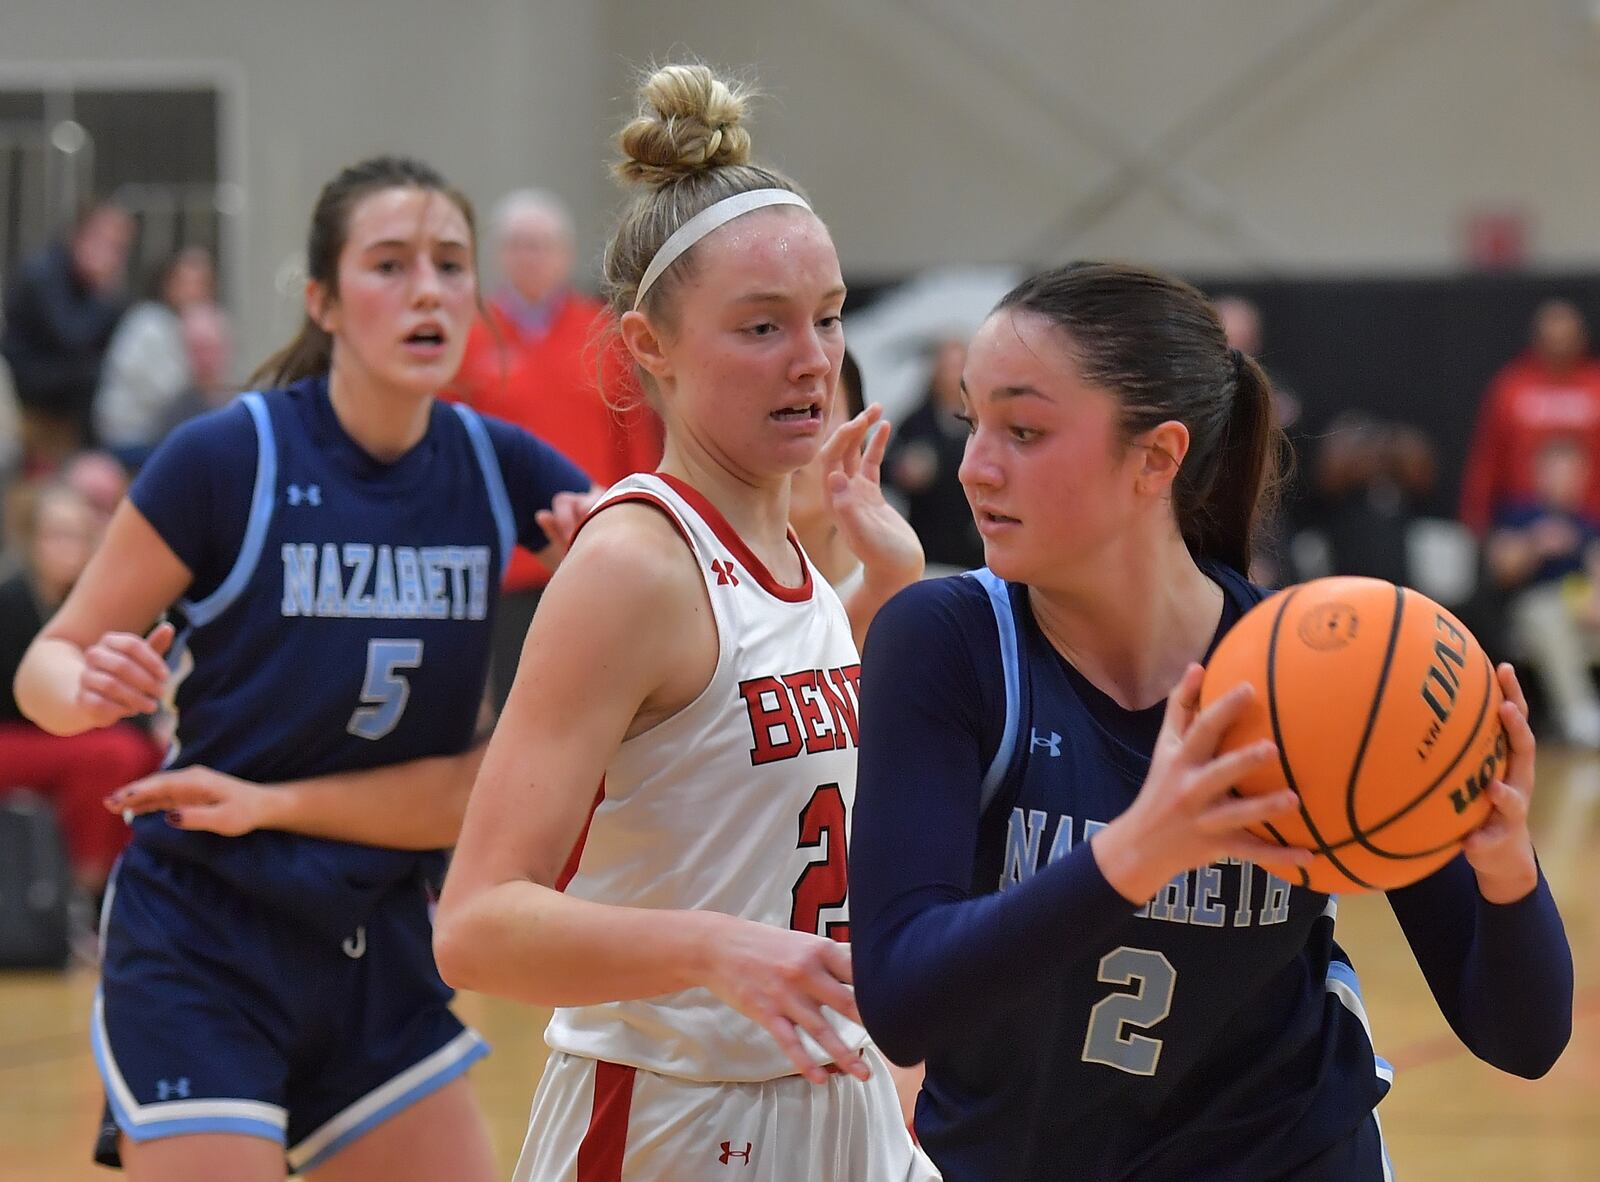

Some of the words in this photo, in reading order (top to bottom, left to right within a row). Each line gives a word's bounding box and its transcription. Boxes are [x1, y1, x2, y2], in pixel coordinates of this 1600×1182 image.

[281, 543, 491, 620] NAZARETH
[346, 638, 424, 741] 5
[739, 663, 861, 766] BEN
[1081, 945, 1177, 1076] 2
